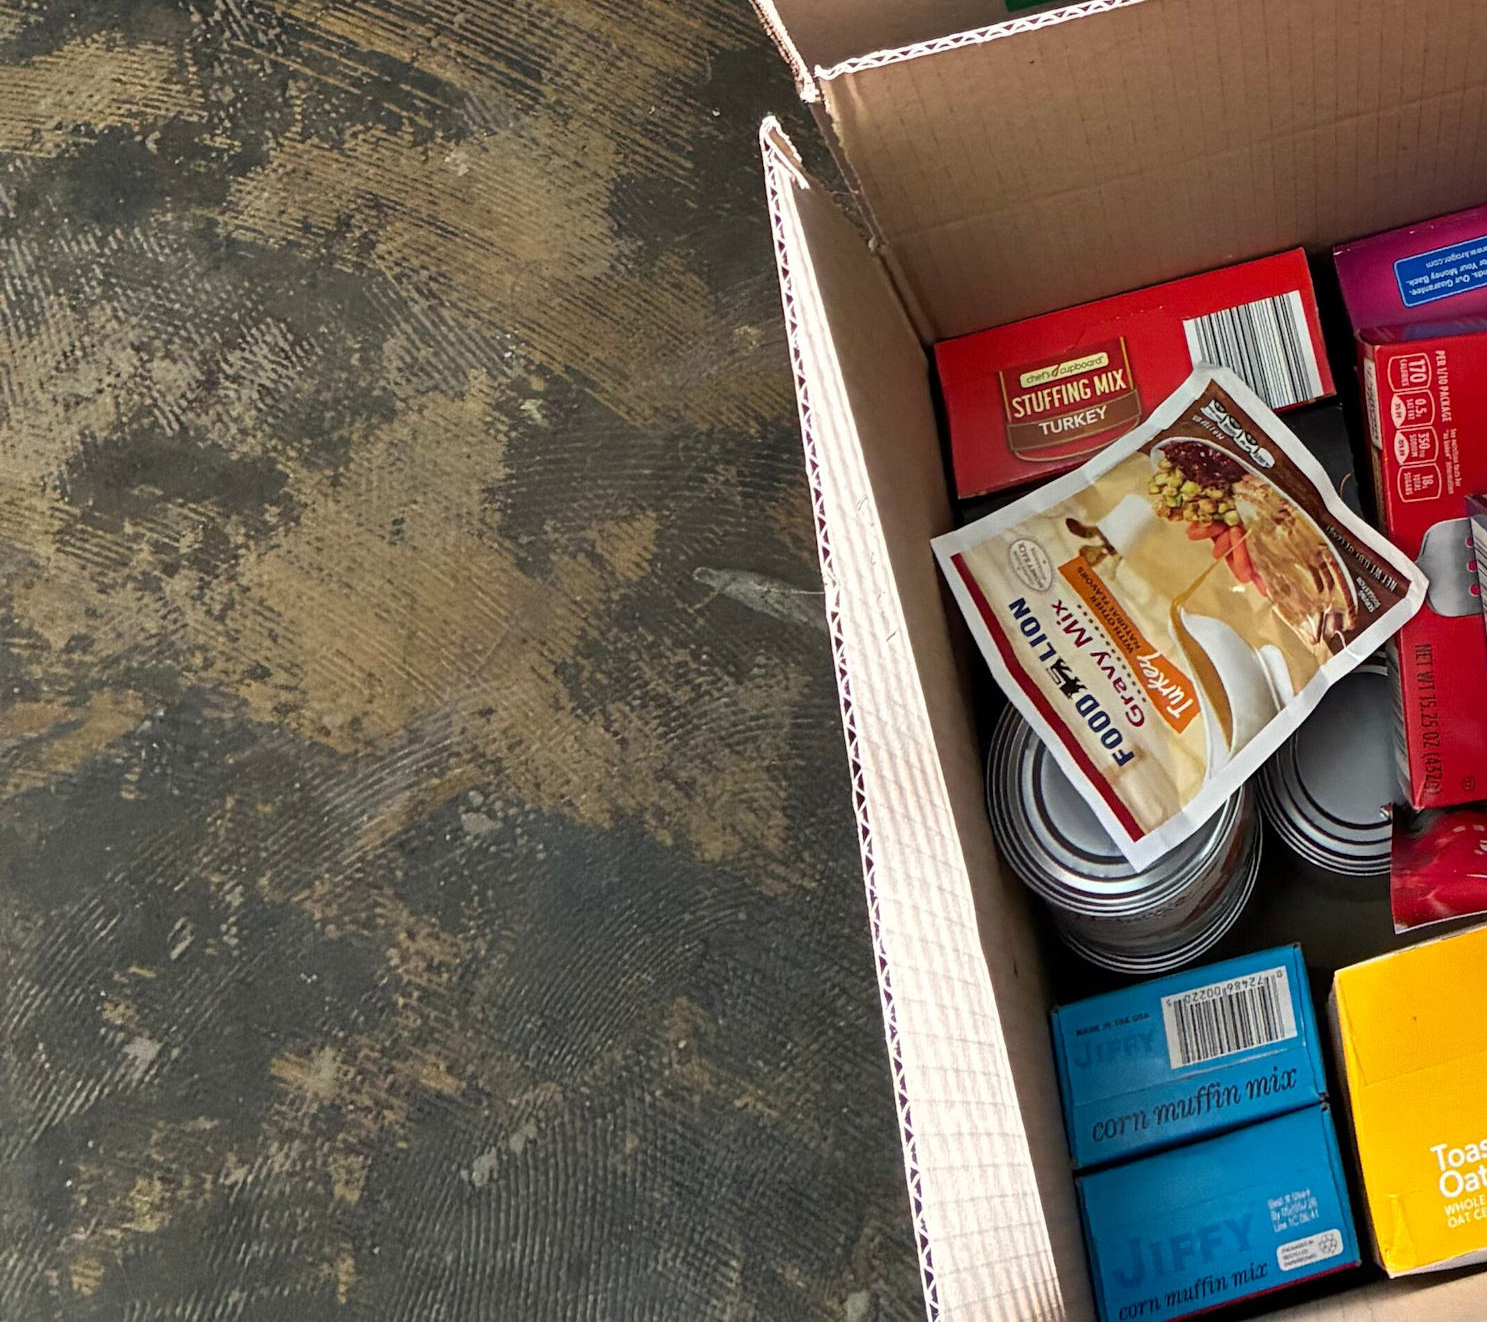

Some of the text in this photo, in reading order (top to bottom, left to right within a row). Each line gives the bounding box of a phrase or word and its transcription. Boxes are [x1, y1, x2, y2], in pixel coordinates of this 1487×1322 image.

[1454, 274, 1470, 285] Our
[1408, 359, 1426, 382] 170
[1434, 349, 1451, 422] PER 1/10 PACKAGE
[1010, 369, 1126, 418] STUFFING MIX
[1038, 406, 1108, 436] TURKEY
[1047, 595, 1151, 730] Gravy Mix
[1414, 644, 1432, 666] NET
[1007, 595, 1135, 769] FOOD LION
[1132, 643, 1196, 721] Turkey
[1417, 671, 1434, 691] WT
[1419, 694, 1437, 727] 15.25
[1422, 731, 1439, 748] OZ
[1088, 1062, 1299, 1142] corn muffin mix
[1443, 1194, 1485, 1215] WHOLE
[1446, 1211, 1471, 1228] OAT
[1106, 1212, 1260, 1292] JIFFY
[1116, 1259, 1270, 1321] corn muffin mix
